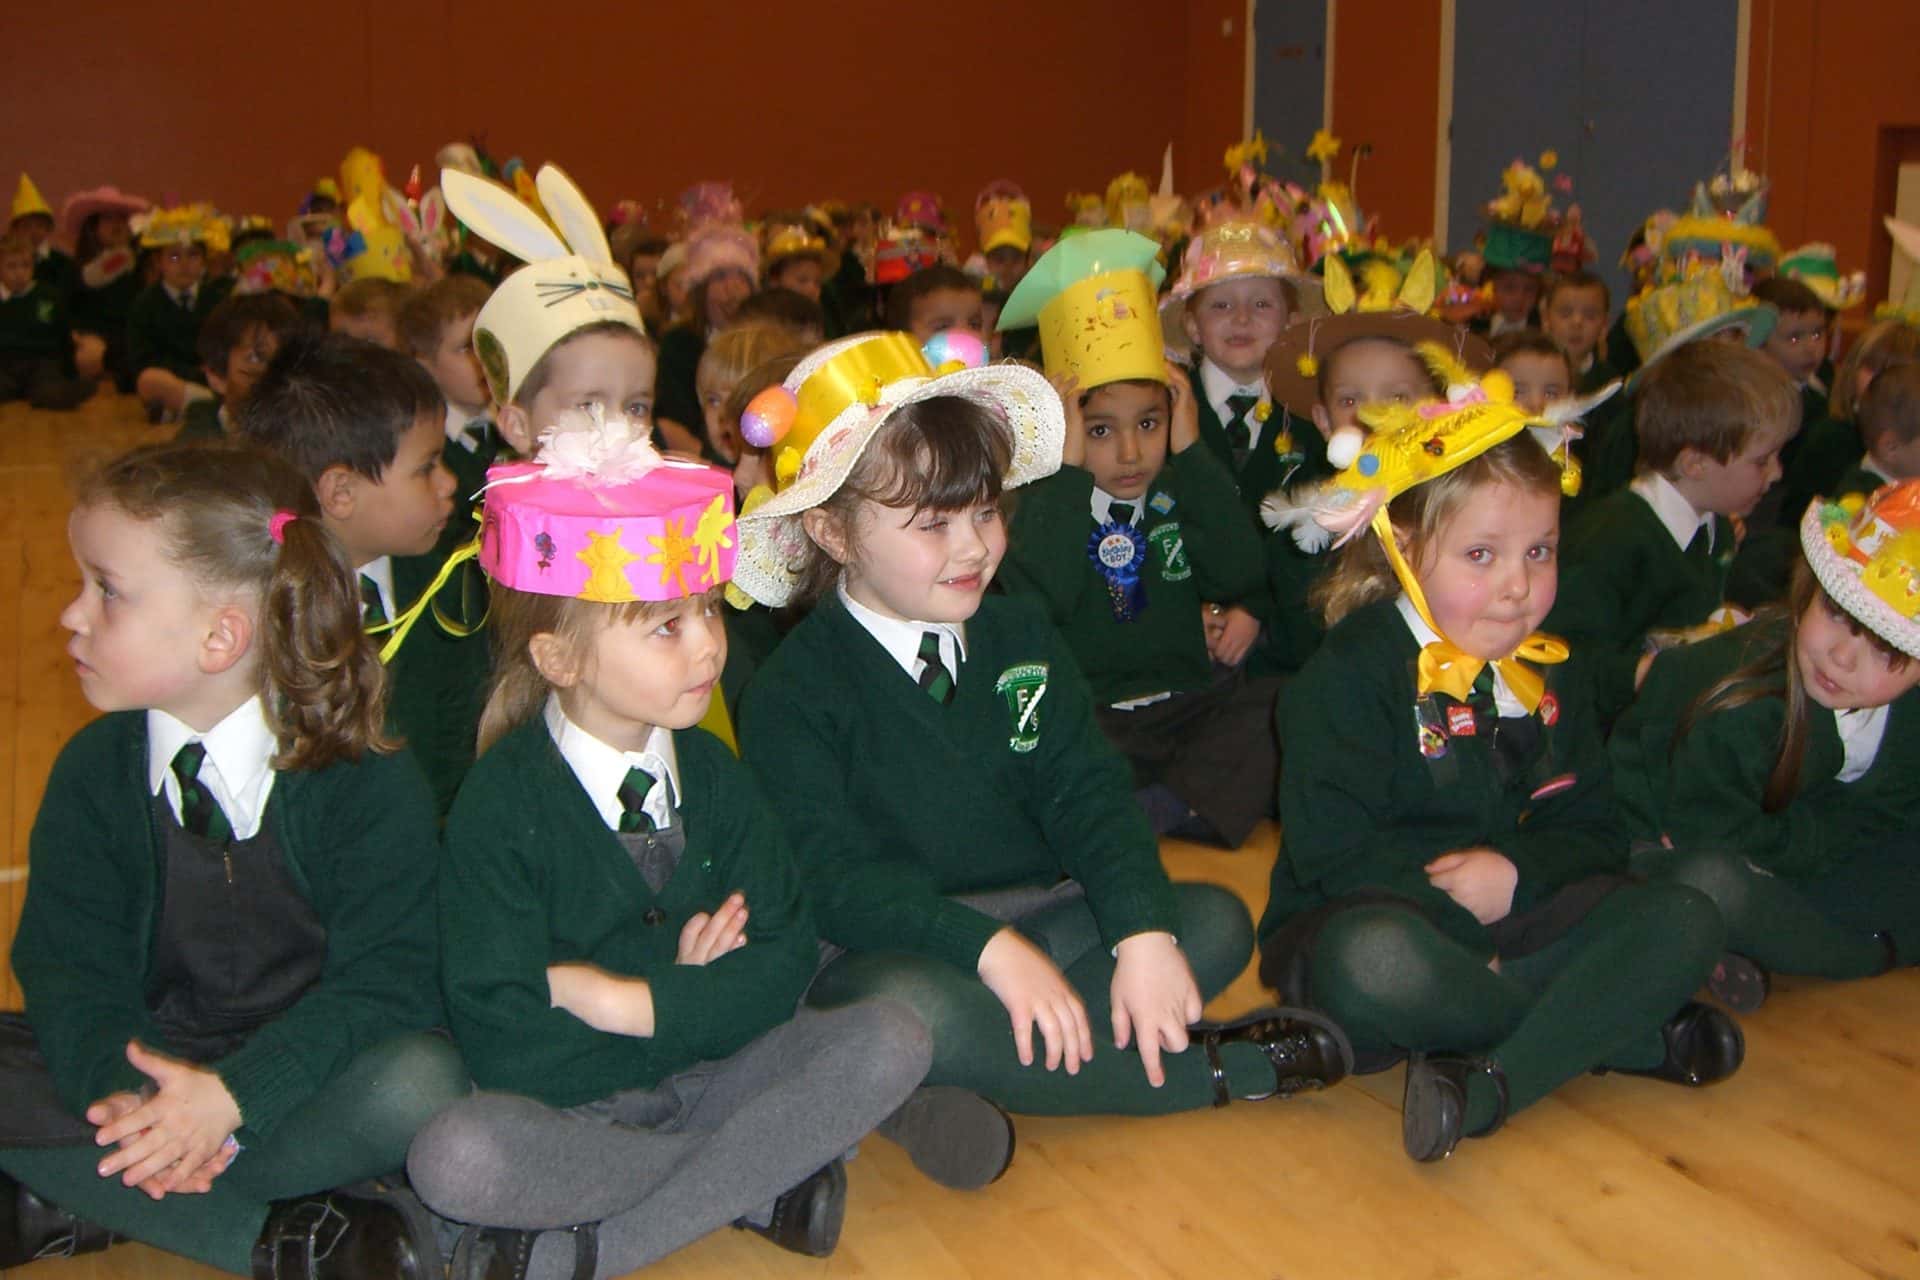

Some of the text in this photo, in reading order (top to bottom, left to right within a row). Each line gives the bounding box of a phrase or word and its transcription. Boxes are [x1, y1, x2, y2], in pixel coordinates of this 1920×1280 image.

[1162, 539, 1172, 555] F
[1110, 553, 1127, 562] BOY
[1017, 688, 1028, 713] F
